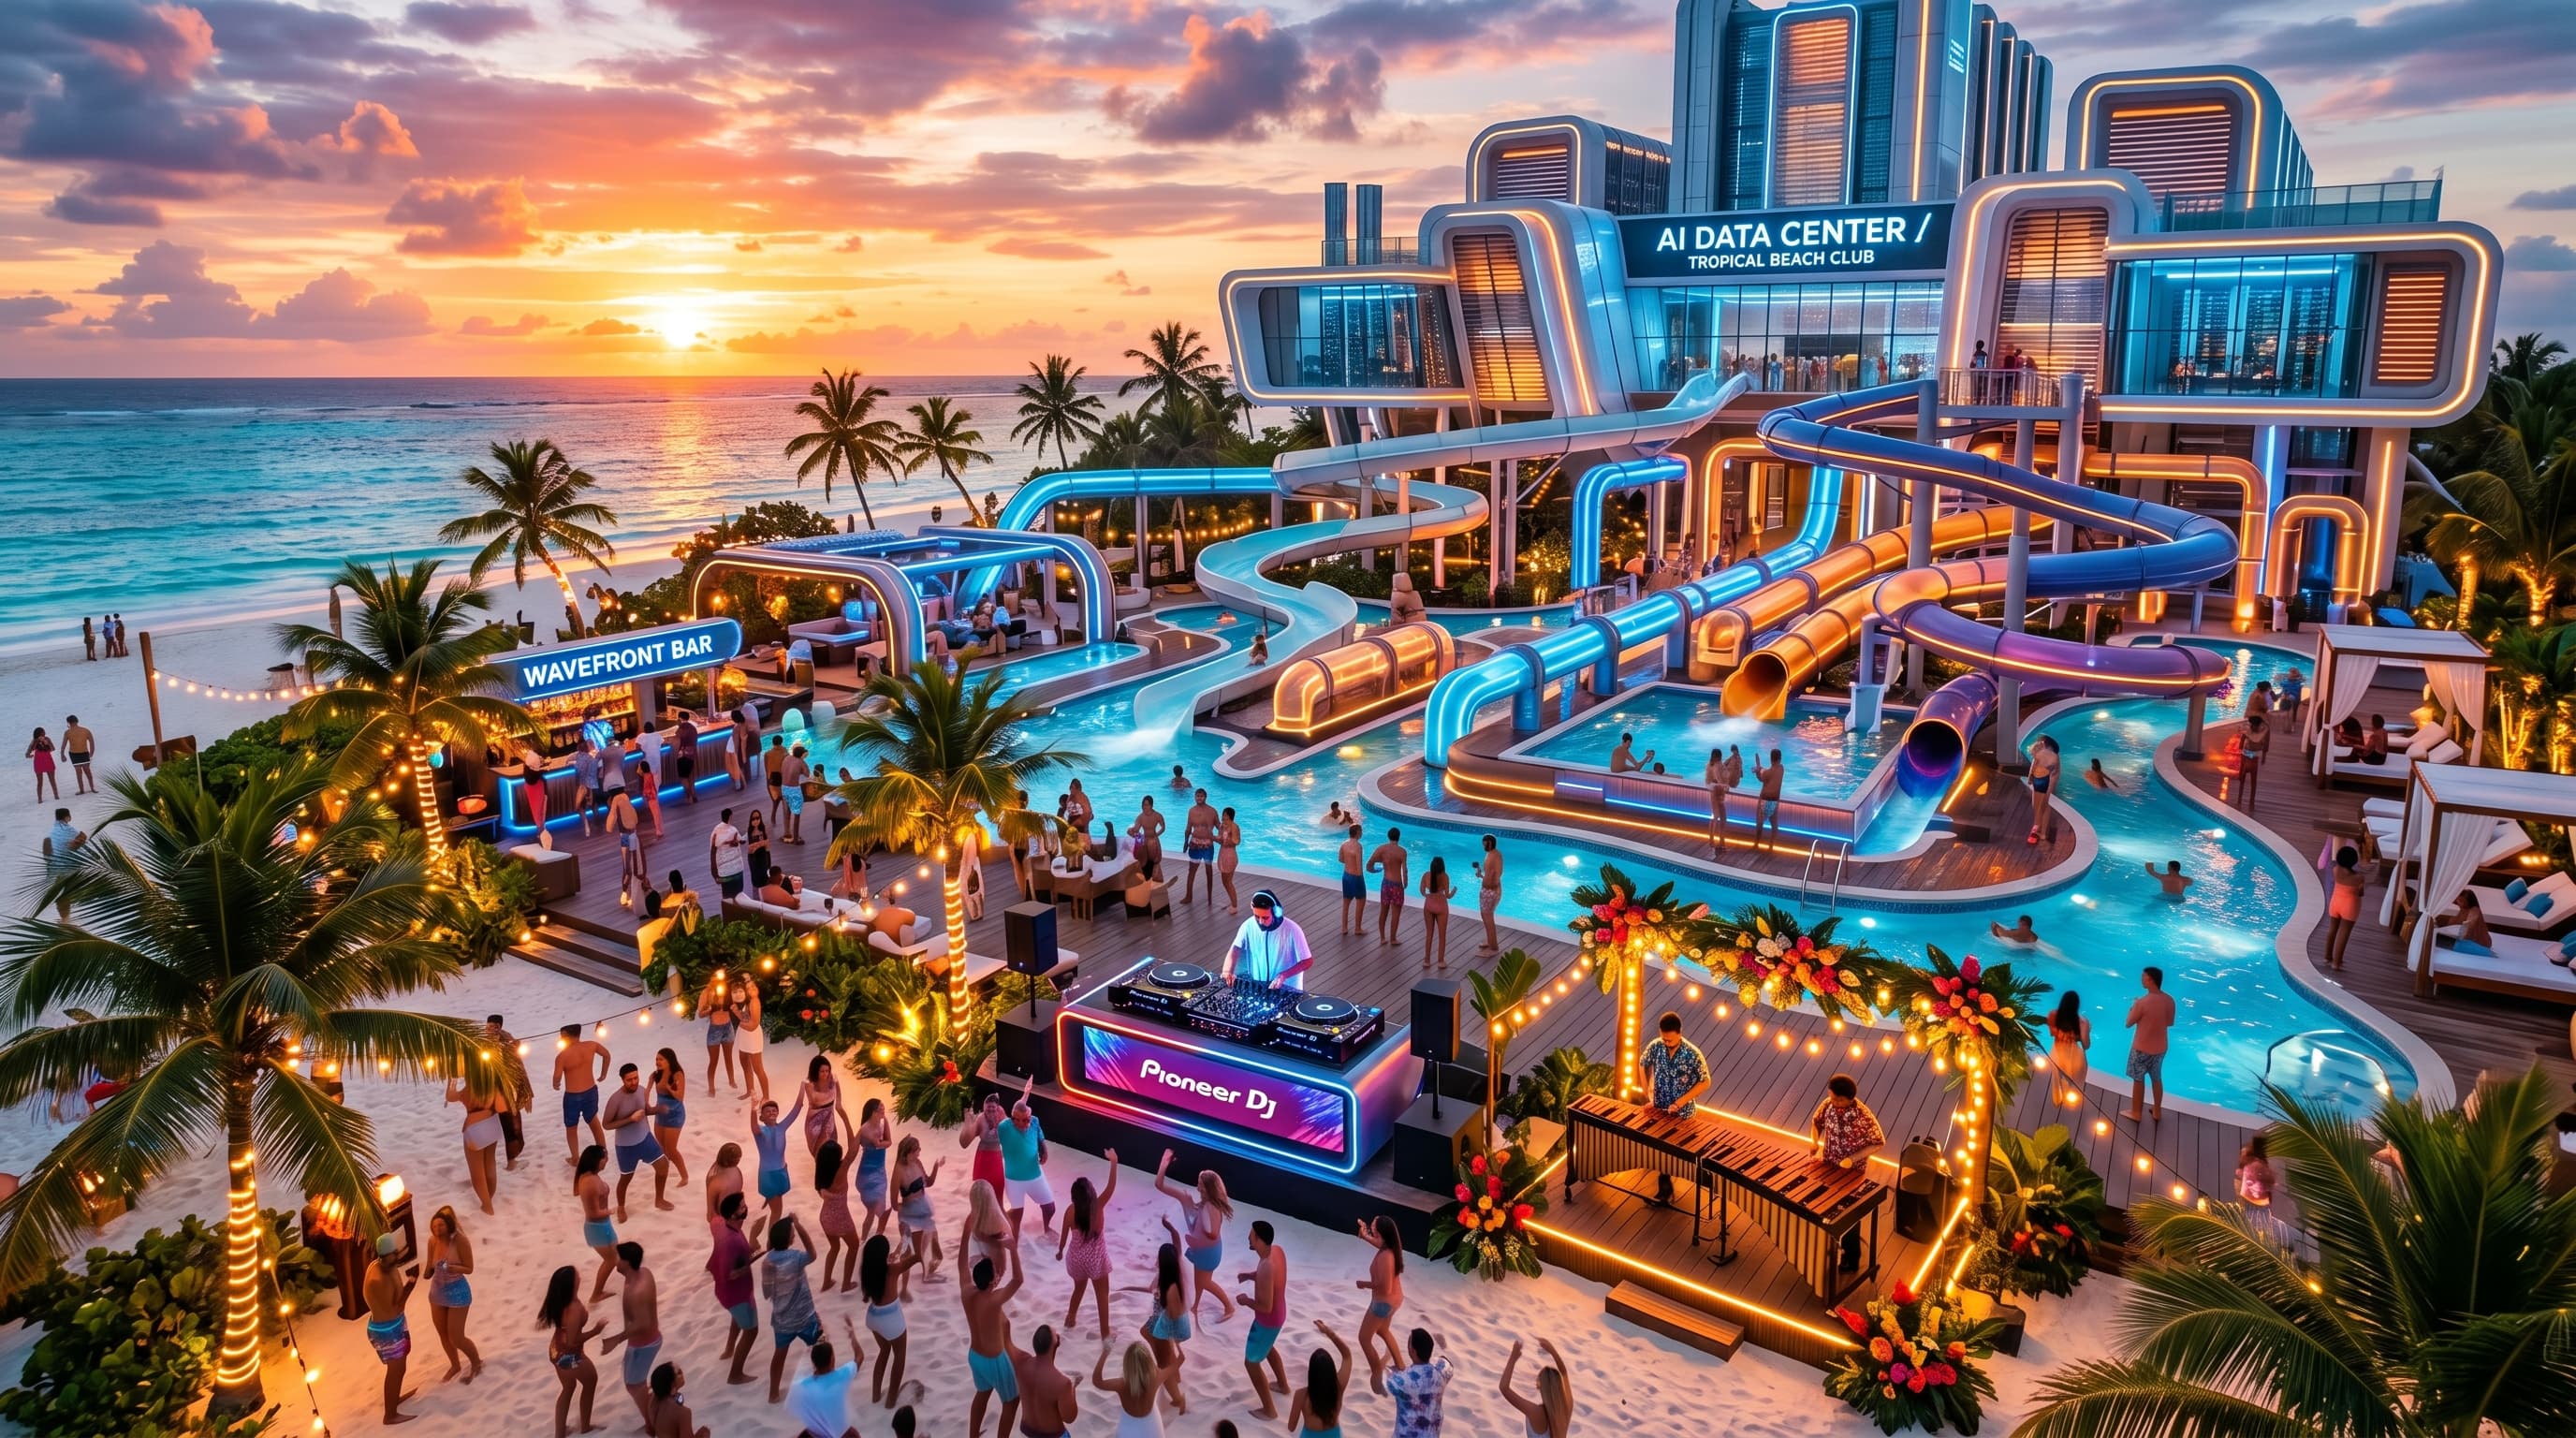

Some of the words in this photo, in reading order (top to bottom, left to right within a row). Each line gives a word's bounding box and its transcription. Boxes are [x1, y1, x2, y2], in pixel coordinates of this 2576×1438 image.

[1656, 227, 1687, 252] AI
[1694, 223, 1773, 250] DATA
[1779, 216, 1907, 247] CENTER
[1913, 212, 1932, 243] /
[1688, 253, 1765, 270] TROPICAL
[1769, 251, 1825, 267] BEACH
[1829, 249, 1875, 265] CLUB
[523, 642, 666, 688] WAVEFRONT
[670, 635, 713, 660] BAR
[1139, 1058, 1242, 1105] Pioneer
